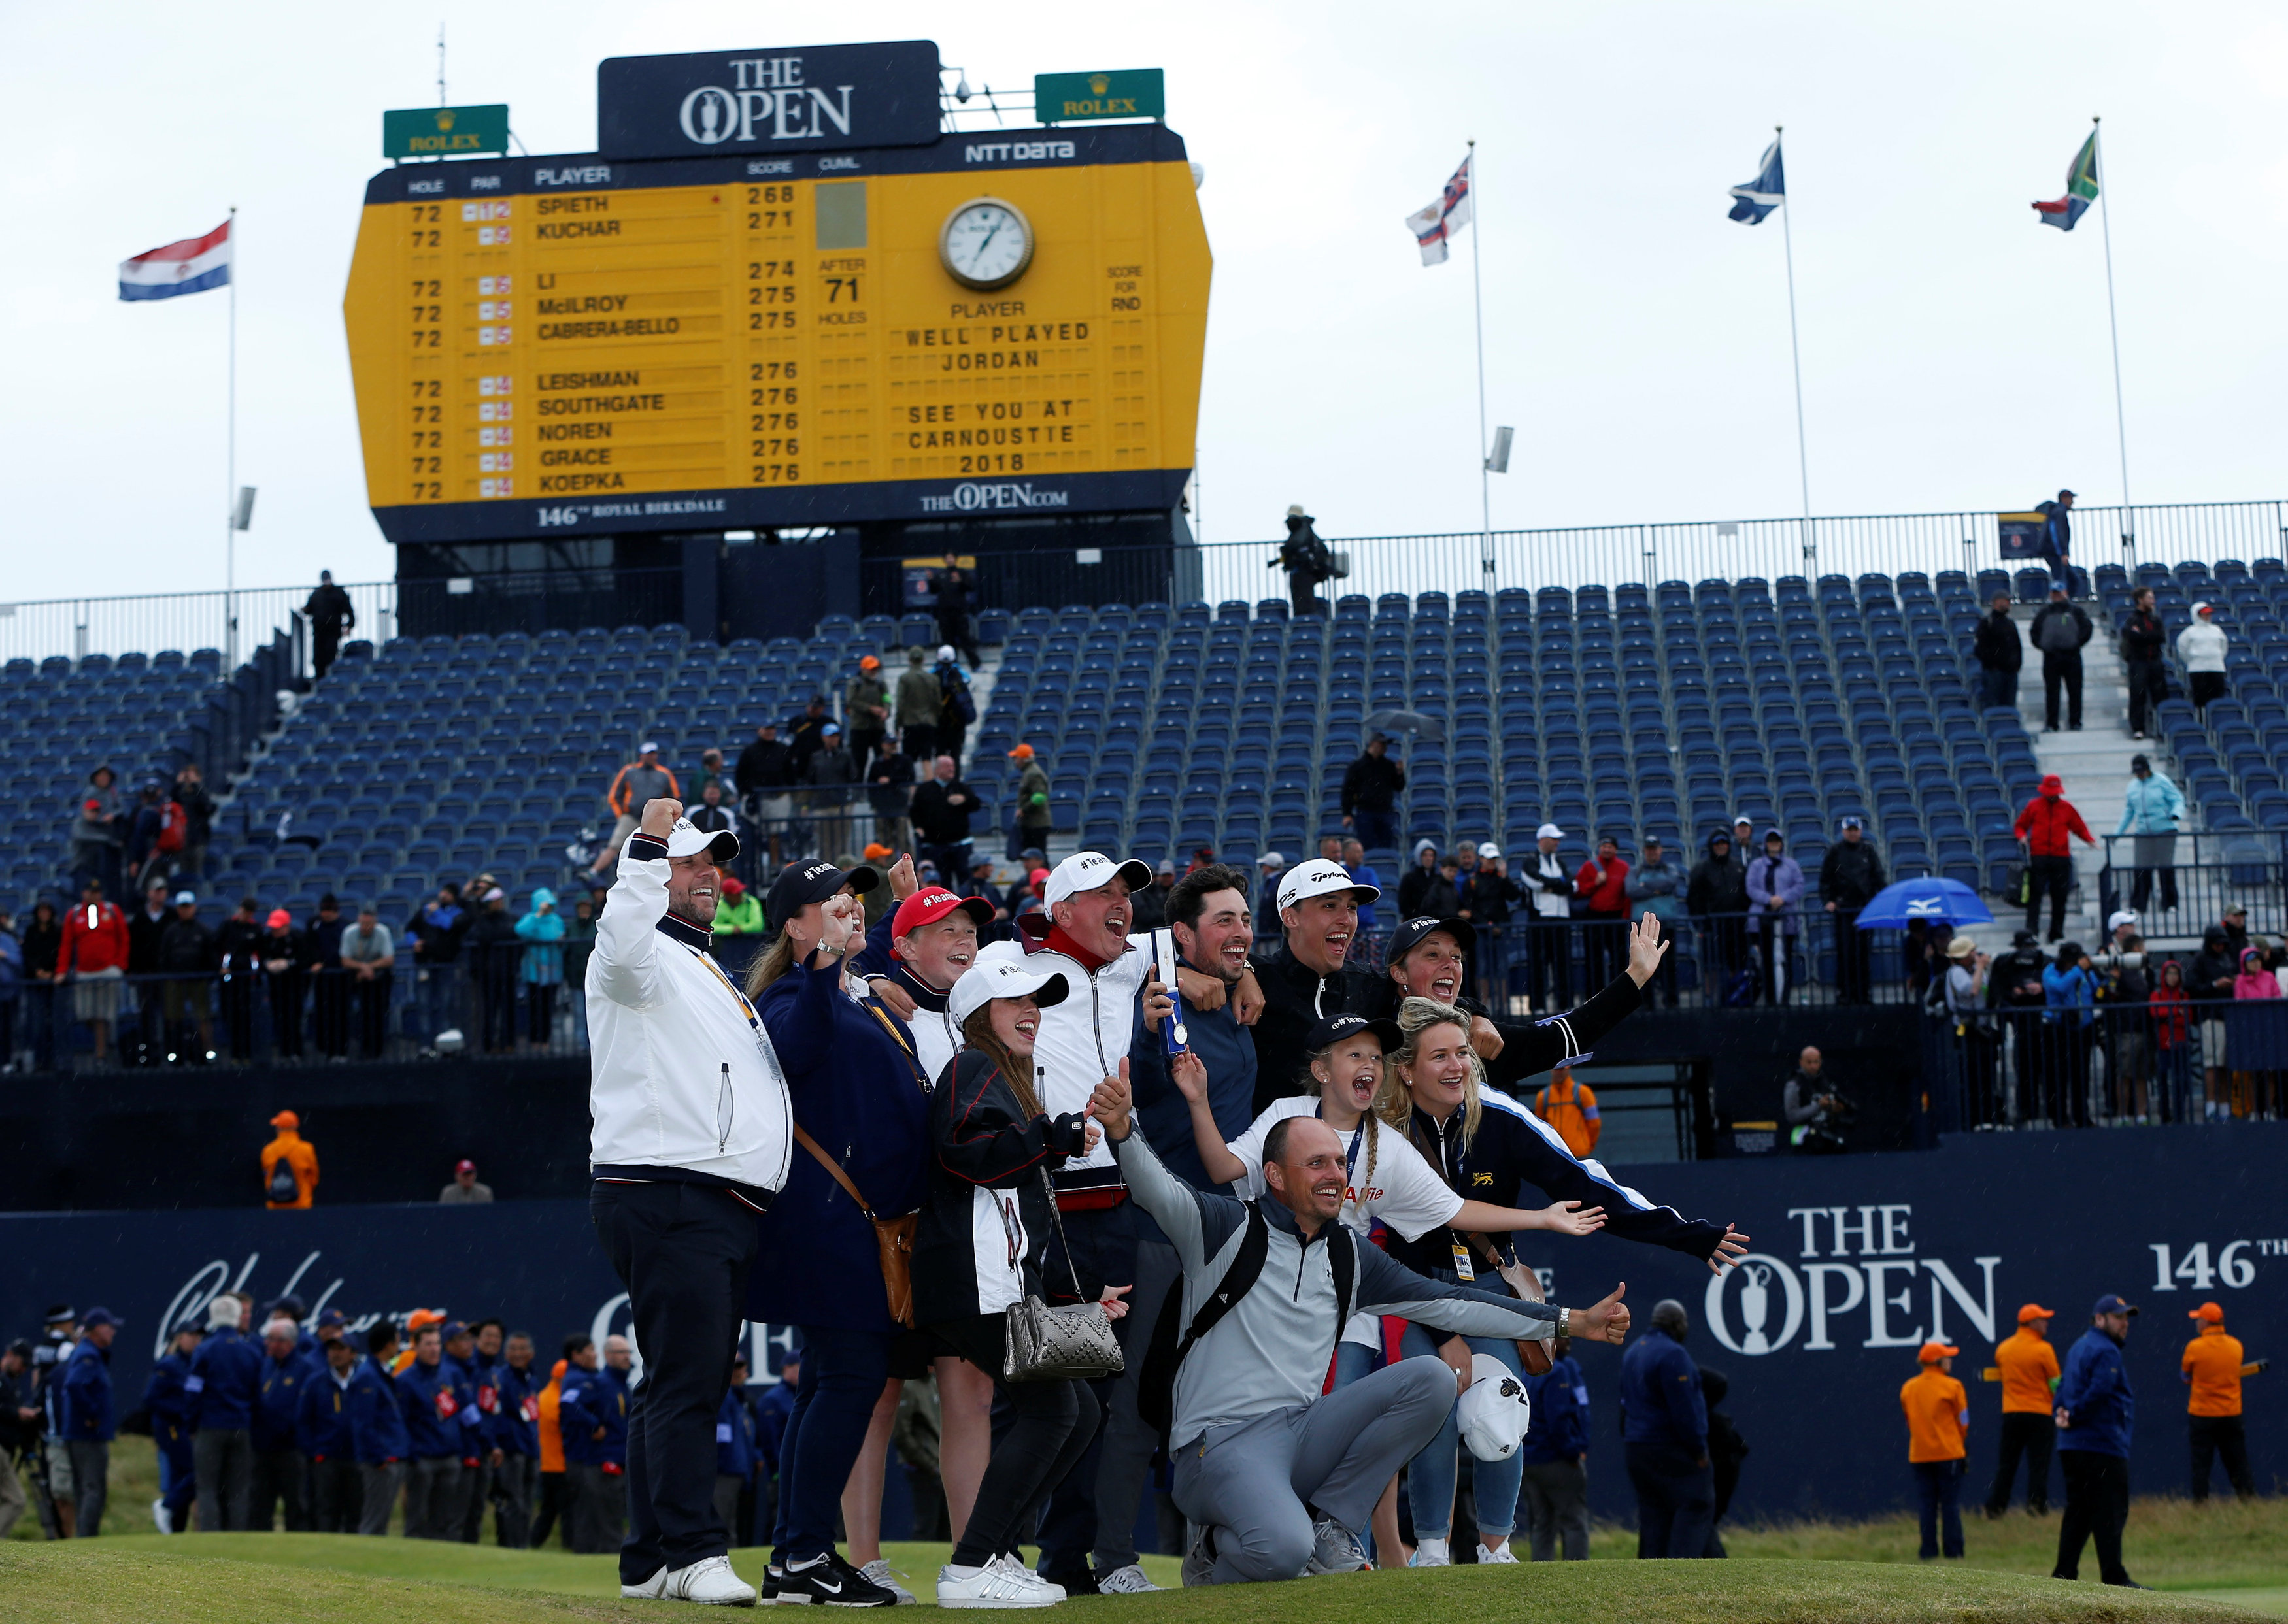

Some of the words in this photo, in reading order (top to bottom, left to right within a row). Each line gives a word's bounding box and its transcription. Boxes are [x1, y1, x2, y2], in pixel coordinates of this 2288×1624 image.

[728, 57, 805, 89] THE
[679, 85, 854, 145] OPEN
[1063, 98, 1137, 116] ROLEX
[409, 135, 480, 151] ROLEX
[965, 143, 1011, 163] NTT
[408, 179, 446, 193] HOLE
[470, 175, 507, 190] PAR
[535, 166, 611, 186] PLAYER
[747, 160, 794, 175] SCORE
[412, 205, 441, 222] 72
[537, 196, 609, 215] SPIETH
[748, 186, 794, 205] 268
[412, 230, 441, 248] 72
[537, 220, 620, 239] KUCHAR
[748, 210, 793, 229] 271
[819, 258, 865, 271] AFTER
[412, 280, 441, 297] 72
[537, 274, 555, 290] LI
[749, 261, 794, 280] 274
[825, 278, 858, 303] 71
[1115, 282, 1136, 293] FOR
[412, 305, 441, 322] 72
[537, 295, 628, 315] McILROY
[749, 286, 795, 305] 275
[819, 311, 867, 325] HOLES
[951, 302, 1025, 318] PLAYER
[1112, 297, 1141, 311] RND
[412, 330, 441, 348] 72
[539, 317, 679, 340] CABRERA-BELLO
[750, 311, 796, 329] 275
[907, 328, 969, 347] WELL
[992, 323, 1088, 344] PLAYED
[943, 350, 1038, 371] JORDAN
[412, 380, 441, 398] 72
[537, 371, 639, 391] LEISHMAN
[751, 361, 797, 380] 276
[412, 406, 441, 423] 72
[539, 394, 665, 416] SOUTHGATE
[752, 388, 798, 406] 276
[909, 405, 955, 423] SEE
[976, 402, 1022, 420] YOU
[1043, 400, 1072, 418] AT
[412, 431, 441, 448] 72
[538, 422, 612, 441] NOREN
[752, 413, 798, 431] 276
[909, 425, 1073, 449] CARNOUSTIE
[412, 456, 441, 474] 72
[541, 448, 611, 467] GRACE
[752, 439, 799, 457] 276
[960, 454, 1023, 472] 2018
[412, 482, 441, 499] 72
[539, 472, 624, 491] KOEPKA
[753, 464, 799, 482] 276
[592, 502, 642, 518] ROYAL
[645, 498, 726, 515] BIRKDALE
[1787, 1204, 1915, 1257] THE
[1704, 1253, 2002, 1356] OPEN
